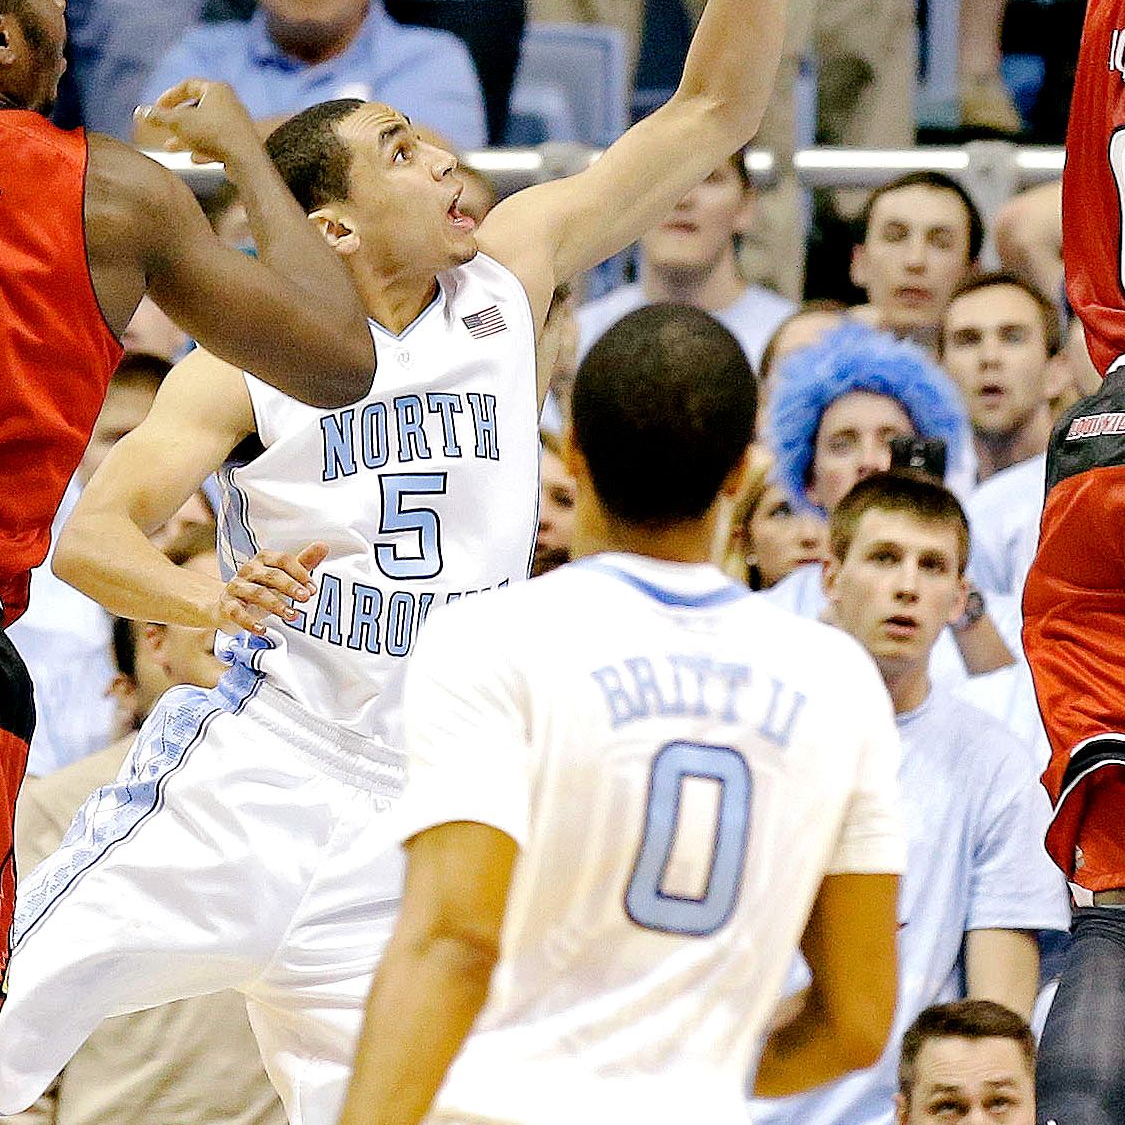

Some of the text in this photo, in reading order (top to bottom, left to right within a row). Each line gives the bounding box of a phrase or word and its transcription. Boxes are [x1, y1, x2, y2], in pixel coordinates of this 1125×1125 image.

[320, 392, 500, 482] NORTH
[374, 471, 448, 581] 5
[590, 651, 752, 730] BRITT
[622, 738, 753, 938] 0
